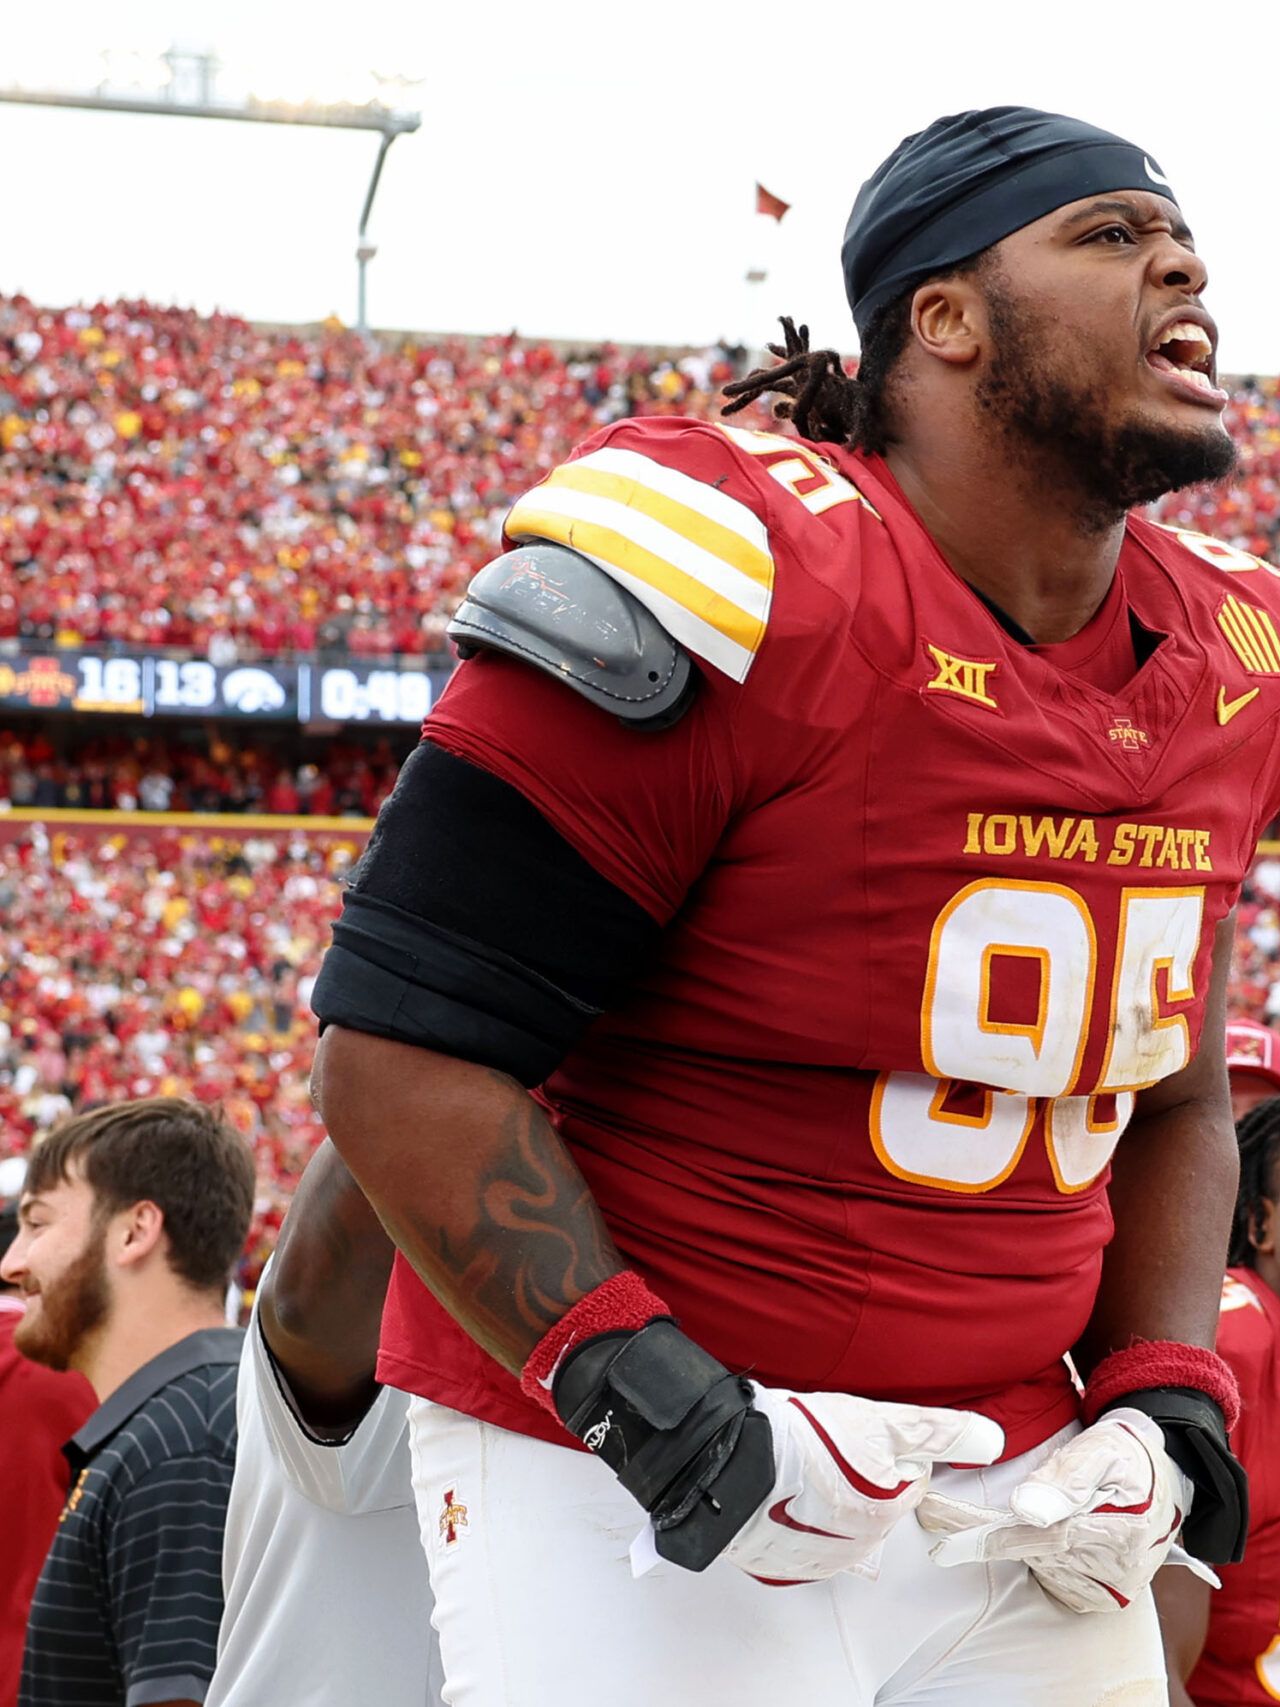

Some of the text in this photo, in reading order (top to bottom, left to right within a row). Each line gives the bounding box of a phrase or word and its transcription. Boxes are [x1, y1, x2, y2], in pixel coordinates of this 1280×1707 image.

[78, 656, 142, 703] 16
[155, 660, 217, 707] 13
[927, 643, 997, 708] XII
[1108, 728, 1148, 744] STATE
[963, 813, 1212, 872] IOWA STATE
[869, 877, 1206, 1194] 95
